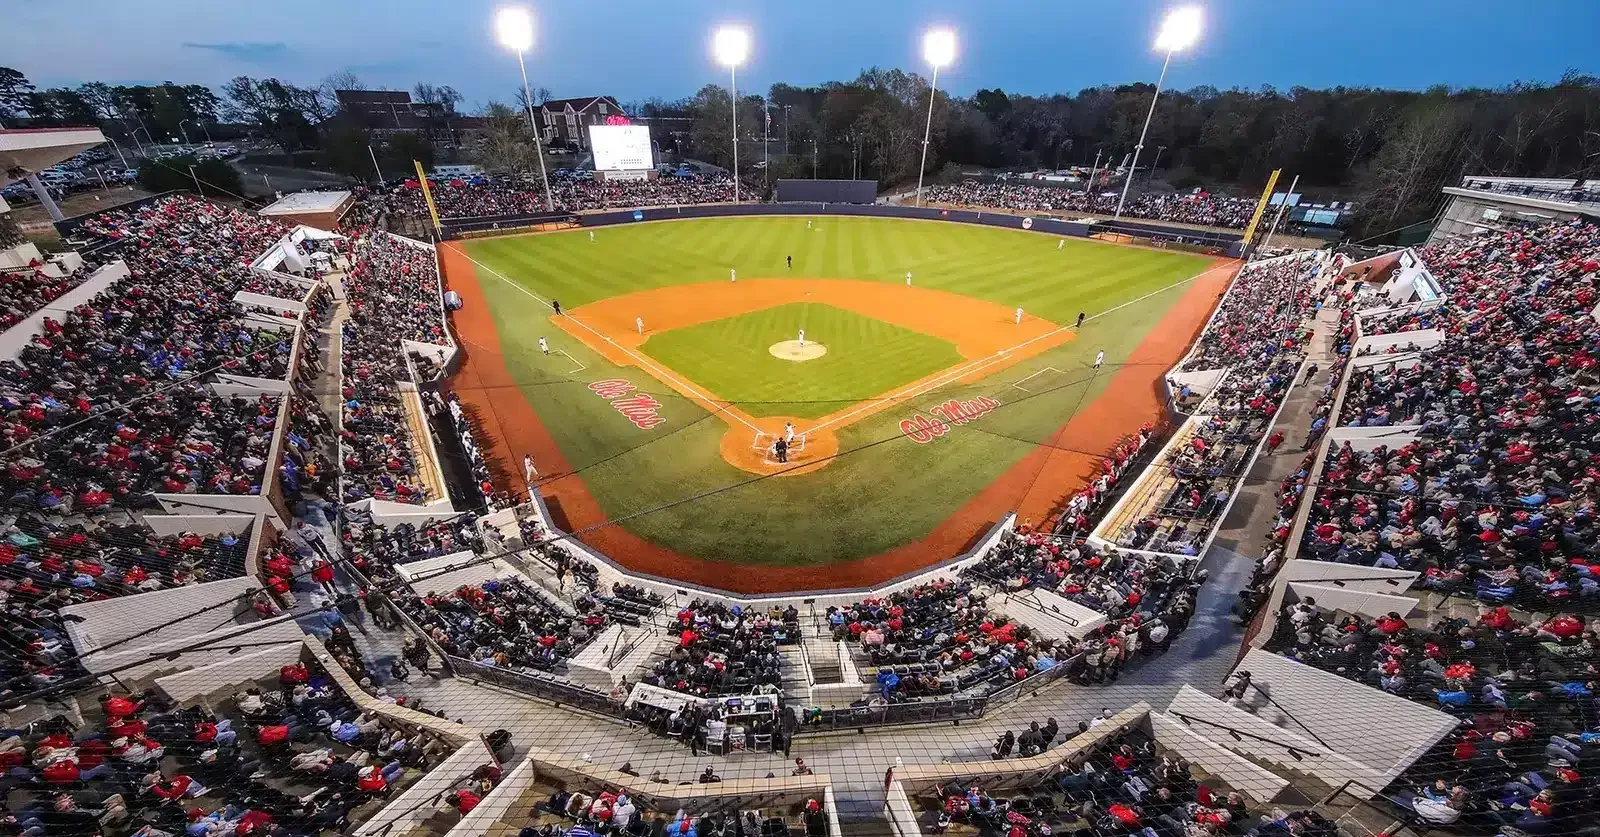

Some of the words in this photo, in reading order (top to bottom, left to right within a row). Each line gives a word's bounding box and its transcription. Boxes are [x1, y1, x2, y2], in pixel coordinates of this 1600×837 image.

[607, 114, 616, 126] Ole
[615, 115, 630, 126] Miss
[588, 379, 637, 398] Ole
[610, 393, 666, 429] Miss
[899, 414, 950, 444] Ole
[929, 396, 1002, 426] Miss
